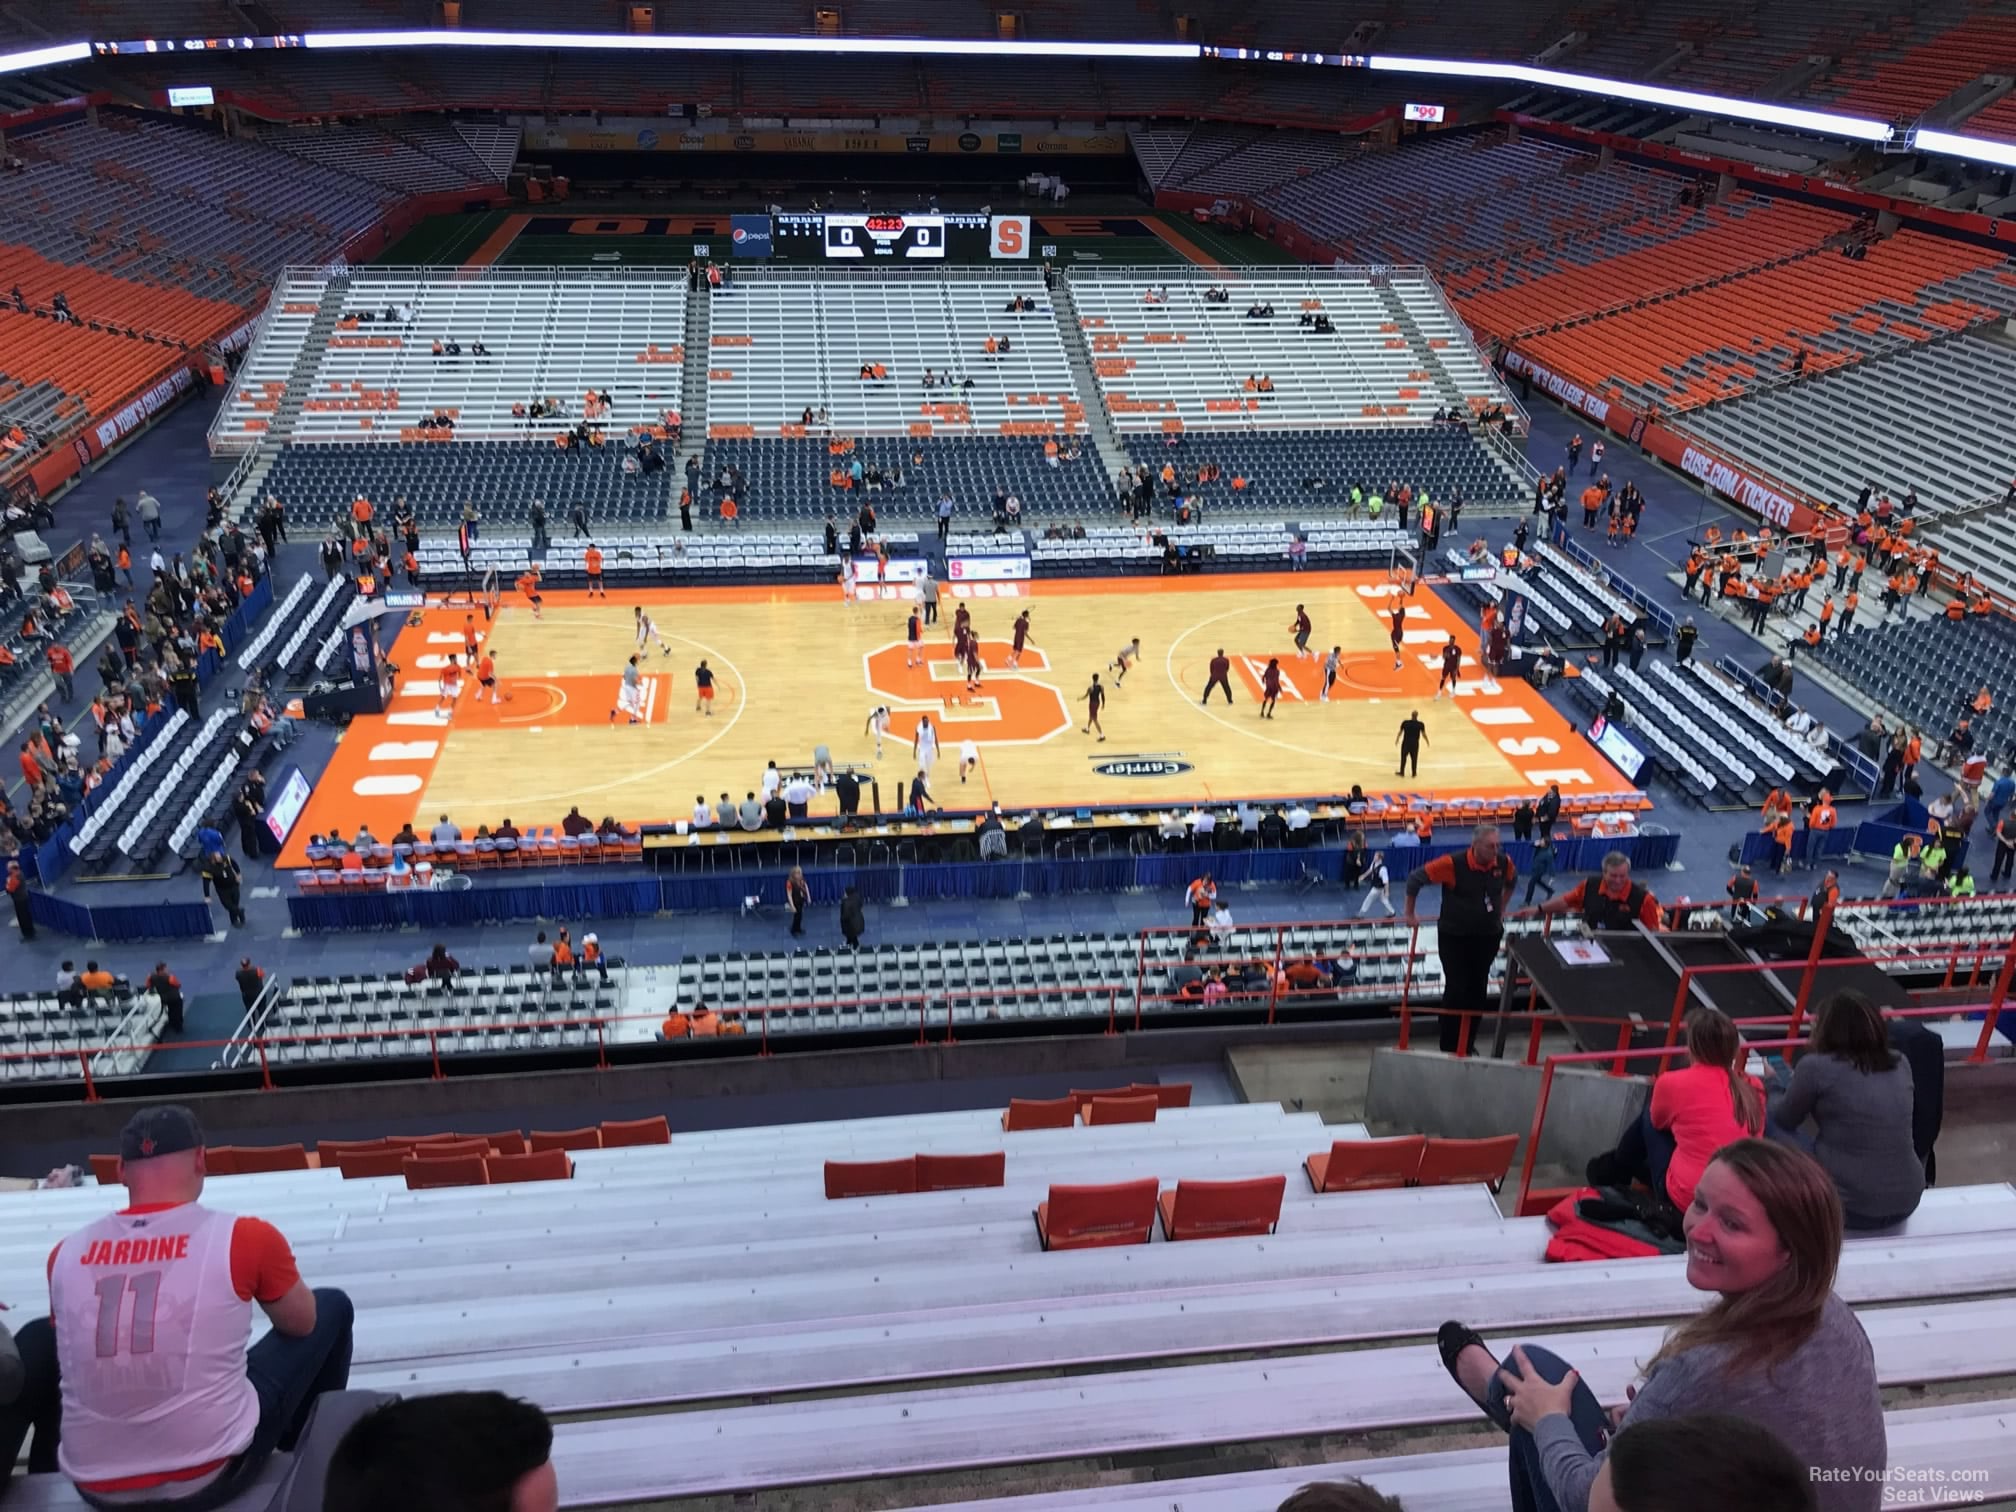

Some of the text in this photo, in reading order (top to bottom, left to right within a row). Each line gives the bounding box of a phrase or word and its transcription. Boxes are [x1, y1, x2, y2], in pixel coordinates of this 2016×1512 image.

[1418, 106, 1437, 118] 99
[1037, 142, 1068, 151] Corona
[867, 219, 903, 230] 42:23
[748, 232, 769, 241] pepsi
[841, 228, 853, 245] 0
[917, 228, 929, 245] 0
[998, 220, 1023, 254] S
[1505, 350, 1525, 373] NEW
[1549, 374, 1586, 408] COLLEGE
[1584, 393, 1610, 421] TEAM
[96, 419, 118, 449] NEW
[114, 400, 145, 435] YORK'S
[142, 379, 174, 415] COLLEGE
[1681, 447, 1795, 527] CUSE.COM/TICKETS
[951, 561, 963, 578] S
[862, 638, 1073, 748] S
[1105, 762, 1179, 775] Carrier
[79, 1234, 190, 1265] JARDINE
[94, 1270, 162, 1358] 11
